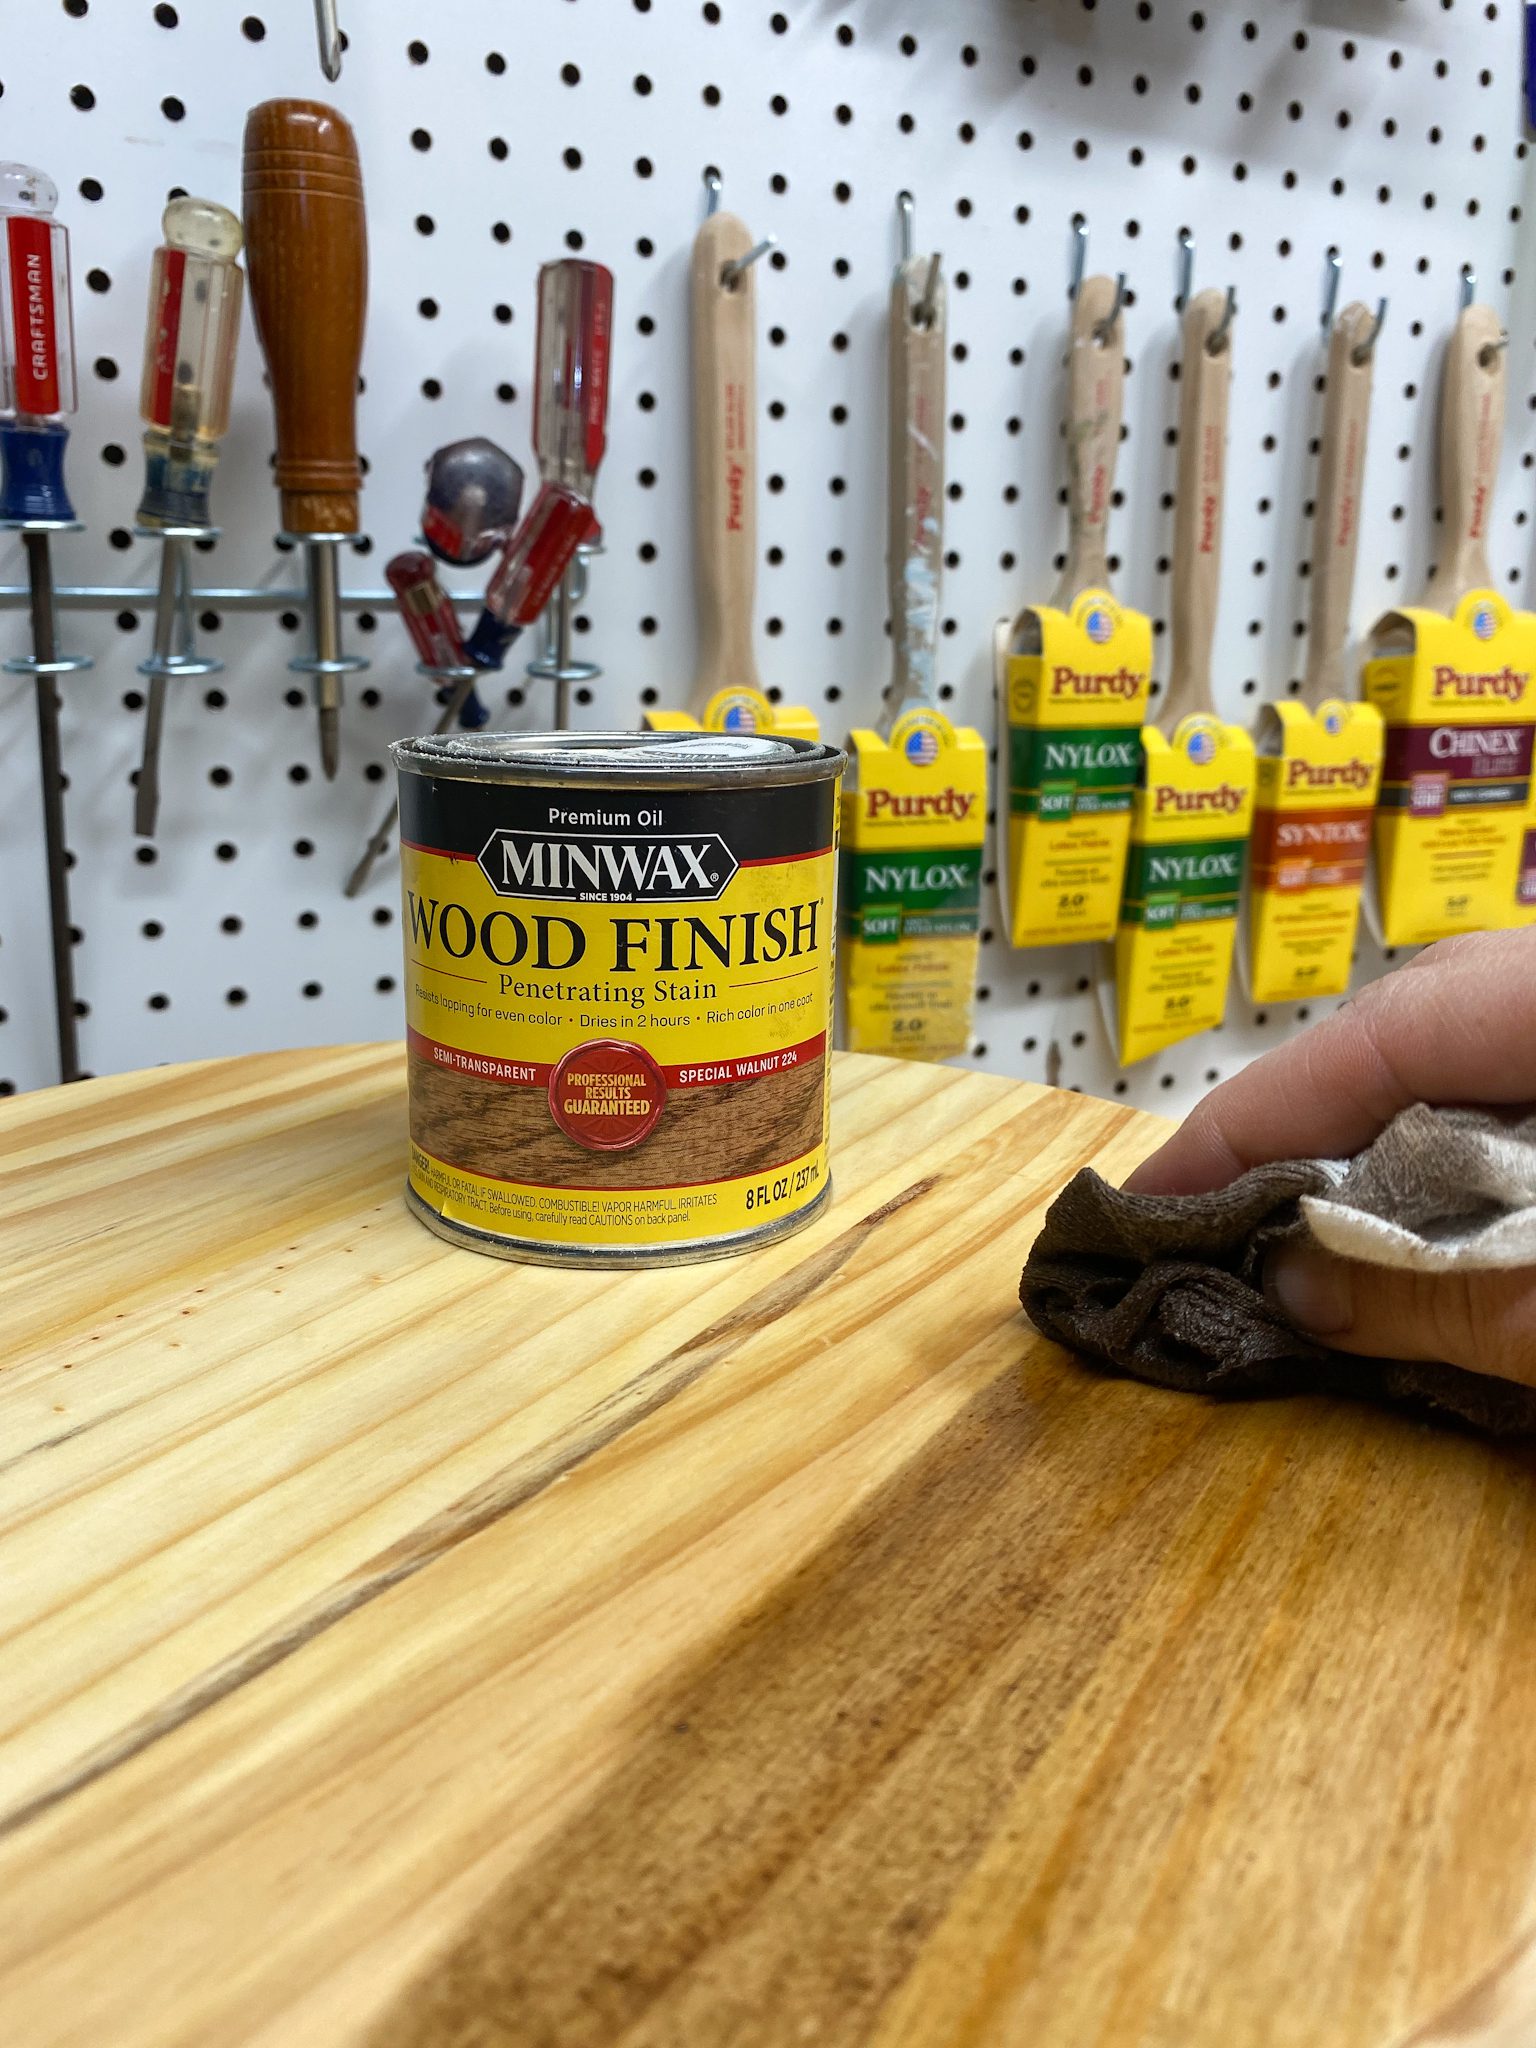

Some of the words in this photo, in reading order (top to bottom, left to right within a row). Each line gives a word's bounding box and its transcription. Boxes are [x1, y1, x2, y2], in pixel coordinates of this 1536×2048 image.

[26, 253, 49, 382] CRAFTSMAN
[725, 462, 745, 532] Purdy
[1052, 666, 1142, 700] Purdy
[1433, 665, 1528, 702] Purdy
[1044, 741, 1136, 771] NYLOX
[1286, 758, 1373, 790] Purdy
[866, 784, 975, 822] Purdy
[1154, 783, 1246, 815] Purdy
[548, 807, 631, 827] Premium
[637, 809, 663, 826] Oil
[500, 838, 714, 891] MINWAX
[864, 862, 970, 894] NYLOX
[1148, 852, 1238, 883] NYLOX
[579, 892, 608, 902] SINCE
[609, 893, 633, 902] 1904
[407, 889, 587, 970] WOOD
[609, 899, 820, 972] FINISH
[415, 983, 439, 1005] Resists
[440, 993, 475, 1018] lapping
[477, 1002, 492, 1018] for
[495, 1010, 525, 1023] even
[528, 1011, 563, 1026] color
[579, 1014, 617, 1028] Dries
[621, 1015, 634, 1028] in
[637, 1016, 647, 1028] 2
[650, 1014, 691, 1027] hours
[706, 1008, 735, 1024] Rich
[737, 1004, 766, 1020] color
[767, 1002, 777, 1015] in
[778, 1000, 795, 1013] one
[796, 992, 813, 1008] coat
[498, 973, 645, 1009] Penetrating
[653, 978, 718, 1002] Stain
[433, 1046, 536, 1082] SEMI-TRANSPARENT
[566, 1072, 647, 1087] PROFESSIONAL
[679, 1064, 733, 1084] SPECIAL
[736, 1055, 780, 1077] WALNUT
[781, 1050, 798, 1067] 224
[563, 1098, 650, 1116] GUARANTEED
[585, 1086, 631, 1100] RESULTS
[461, 1180, 480, 1197] FATAL
[487, 1188, 538, 1208] SWALLOWED.
[538, 1197, 600, 1213] COMBUSTIBLE!
[602, 1201, 632, 1213] VAPOR
[678, 1193, 718, 1210] IRRITATES
[745, 1189, 755, 1210] 8
[757, 1184, 771, 1208] FL
[773, 1177, 788, 1202] OZ
[795, 1165, 810, 1193] 237
[489, 1201, 512, 1217] Before
[512, 1207, 534, 1222] using,
[535, 1210, 568, 1226] carefully
[569, 1211, 587, 1225] read
[588, 1214, 633, 1226] CAUTIONS
[634, 1215, 646, 1225] on
[647, 1212, 666, 1225] back
[667, 1211, 691, 1226] panel.
